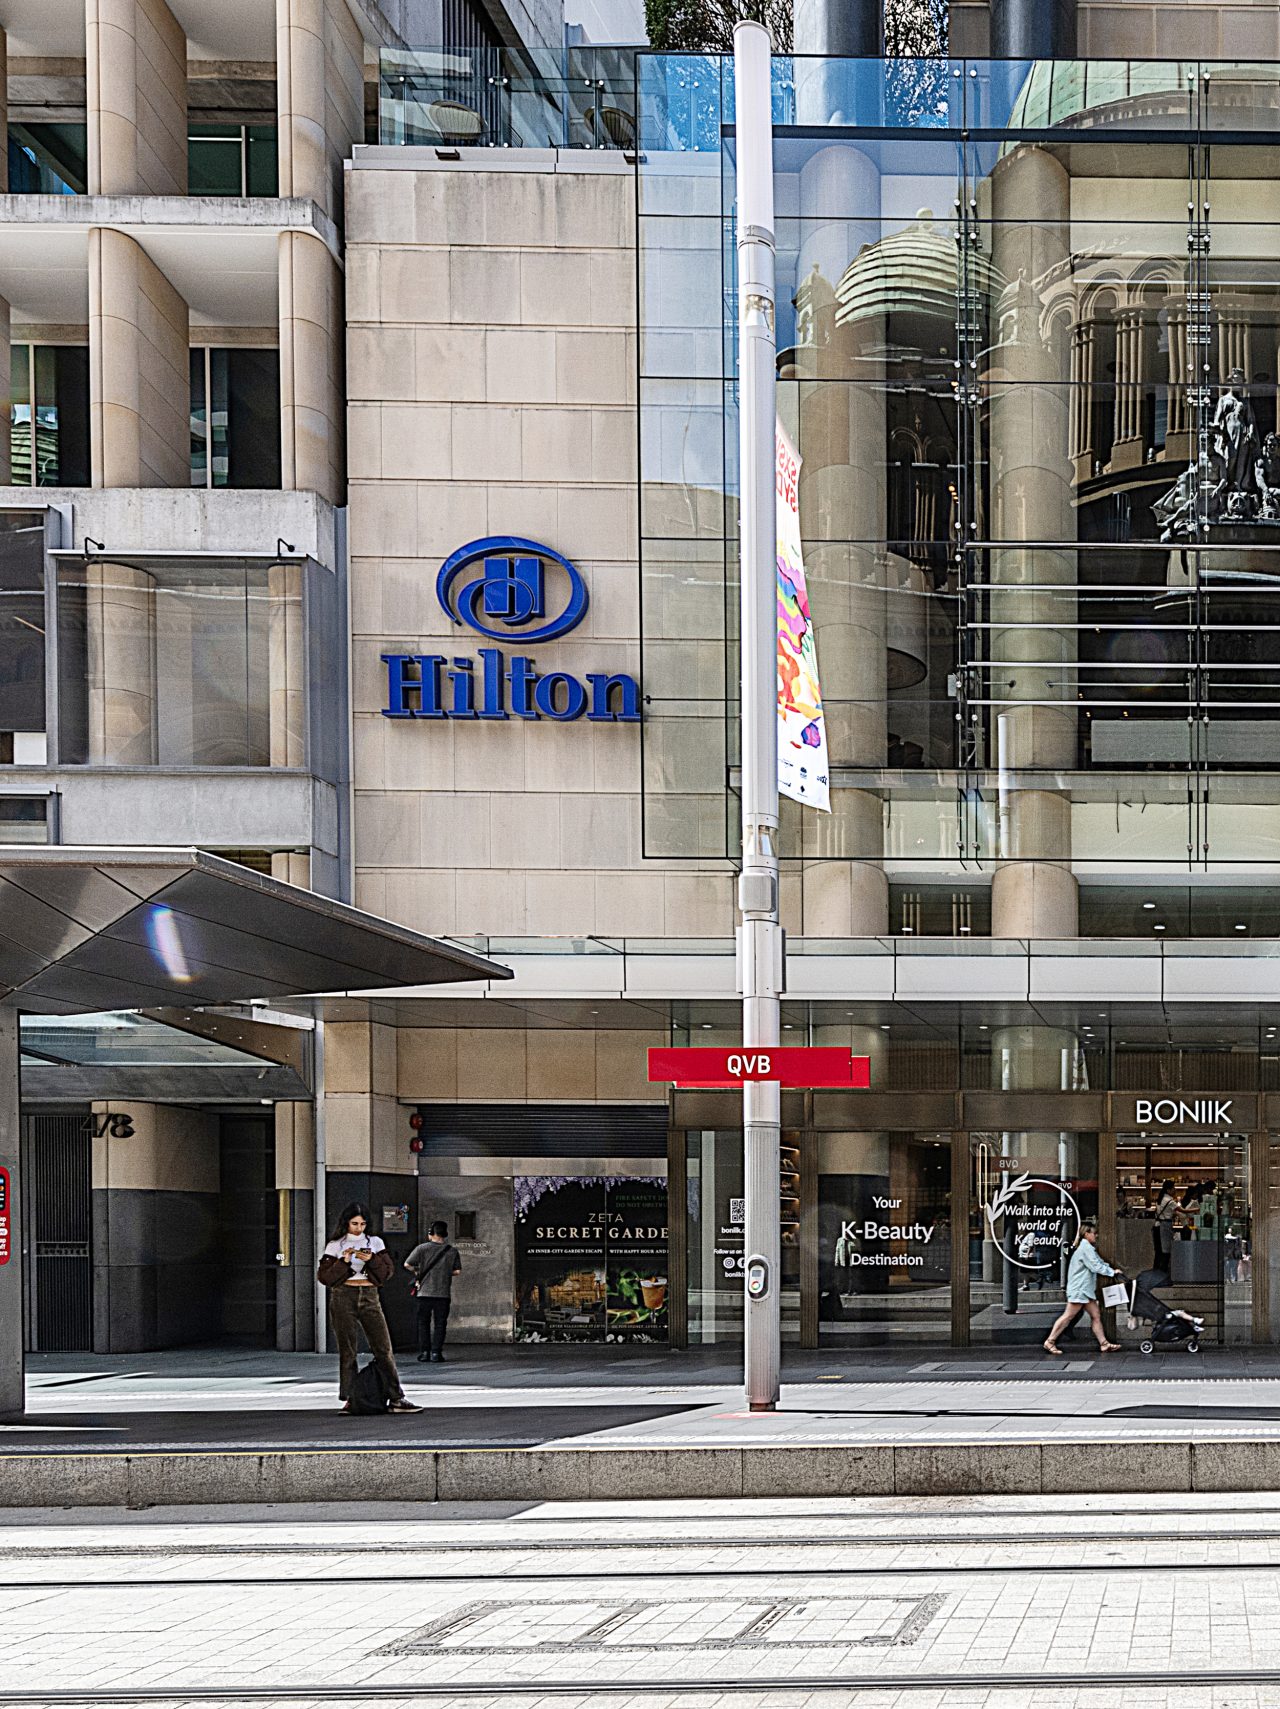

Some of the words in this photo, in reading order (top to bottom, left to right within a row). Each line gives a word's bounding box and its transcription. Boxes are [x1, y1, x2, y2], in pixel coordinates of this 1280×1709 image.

[380, 648, 641, 722] Hilton
[727, 1054, 771, 1077] QVB
[1136, 1099, 1233, 1124] BONIIK
[80, 1113, 136, 1138] 478
[872, 1196, 902, 1209] Your
[1005, 1205, 1032, 1216] Walk
[1033, 1205, 1055, 1216] into
[1056, 1205, 1073, 1216] the
[588, 1213, 624, 1223] ZETA
[1017, 1219, 1047, 1231] world
[1049, 1219, 1061, 1232] of
[536, 1227, 603, 1239] SECRET
[608, 1227, 669, 1239] GARDE
[841, 1221, 935, 1244] K-Beauty
[1014, 1234, 1064, 1248] Keauty
[851, 1253, 924, 1266] Destination
